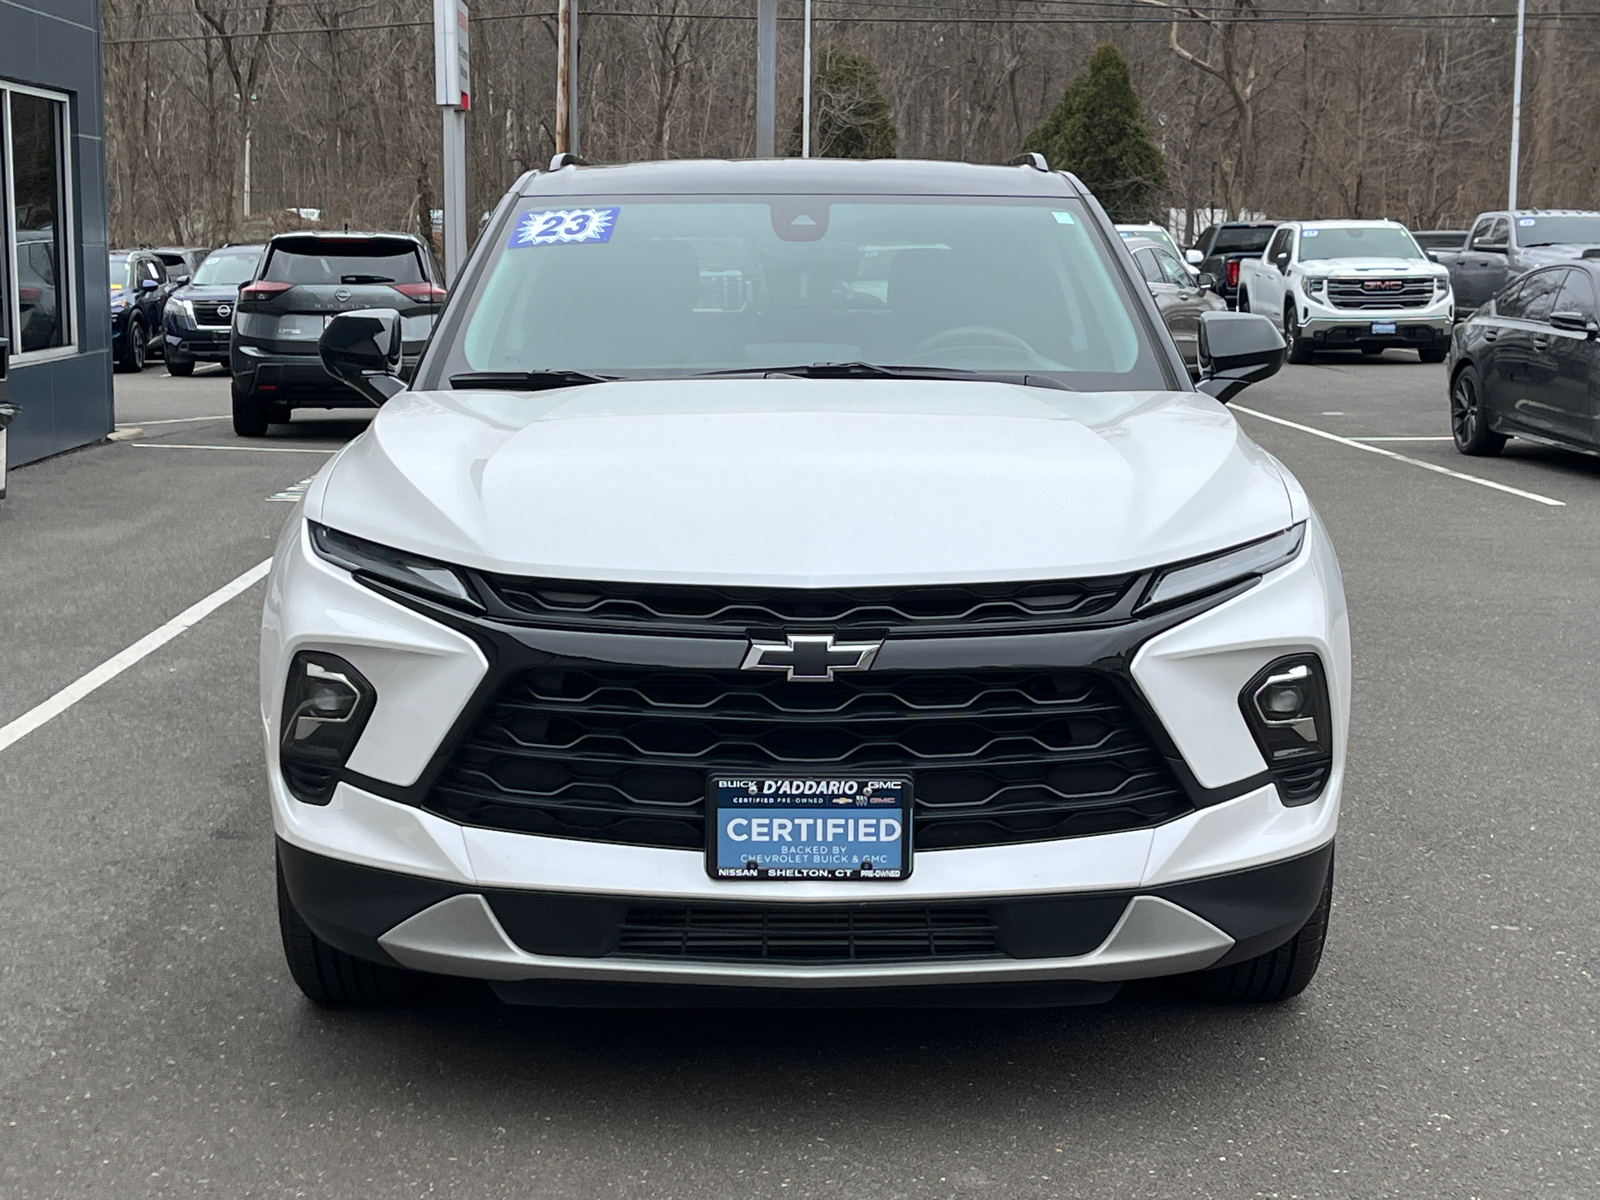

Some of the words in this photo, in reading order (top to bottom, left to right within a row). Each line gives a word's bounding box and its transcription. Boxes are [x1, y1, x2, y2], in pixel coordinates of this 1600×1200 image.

[534, 214, 591, 238] 23
[1363, 280, 1403, 290] GMC
[718, 780, 757, 789] BUICK
[867, 780, 902, 790] GMC
[726, 817, 902, 843] CERTIFIED
[781, 845, 828, 855] BACKED
[832, 845, 847, 855] BY
[740, 854, 809, 864] CHEVROLET
[813, 854, 849, 864] BUICK
[851, 854, 859, 864] &
[863, 854, 888, 864] GMC
[718, 868, 758, 878] NISSAN
[767, 868, 832, 879] SHELTON,
[835, 868, 853, 878] CT
[860, 869, 901, 879] PRE-OWNED
